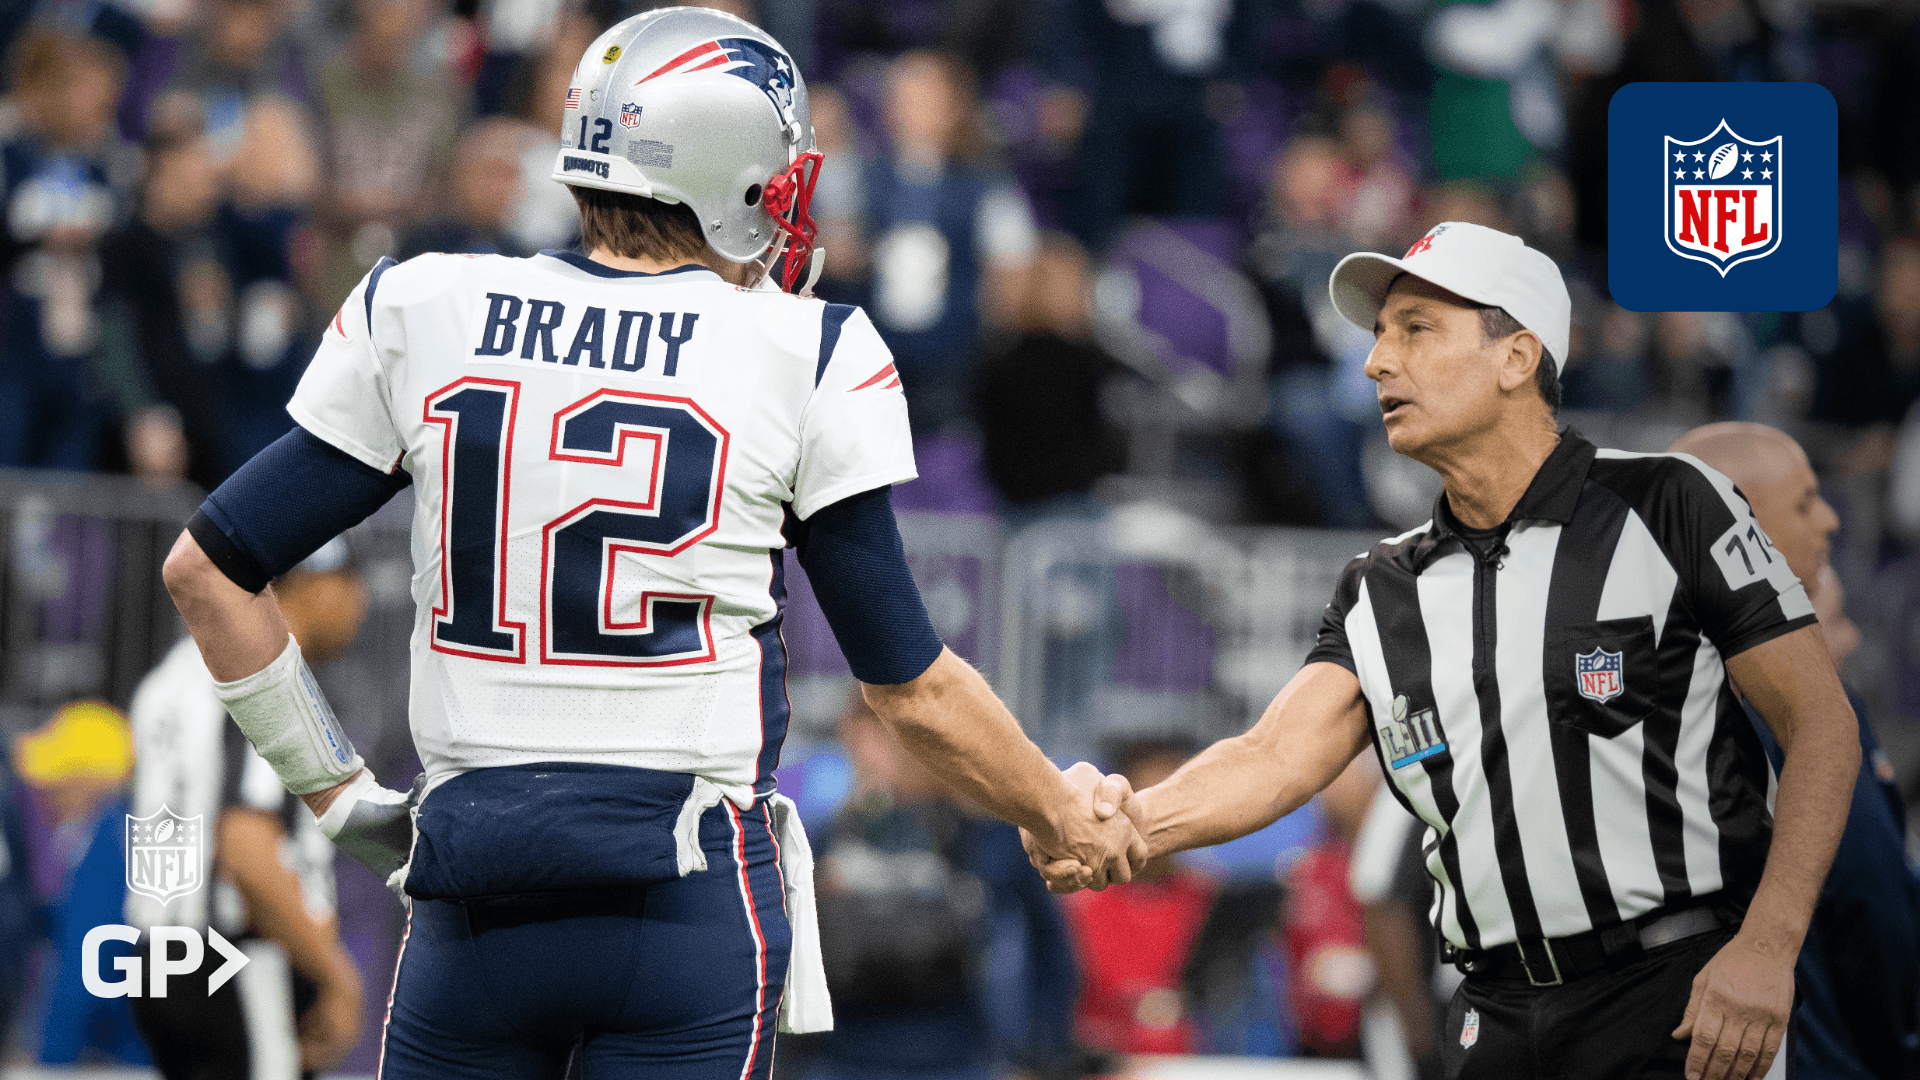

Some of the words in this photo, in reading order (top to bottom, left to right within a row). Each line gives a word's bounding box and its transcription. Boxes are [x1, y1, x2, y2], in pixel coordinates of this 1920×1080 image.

[578, 115, 613, 155] 12
[621, 112, 639, 126] NFL
[563, 155, 610, 179] PATRIOTS
[474, 291, 700, 377] BRADY
[422, 375, 731, 668] 12
[1581, 671, 1619, 696] NFL
